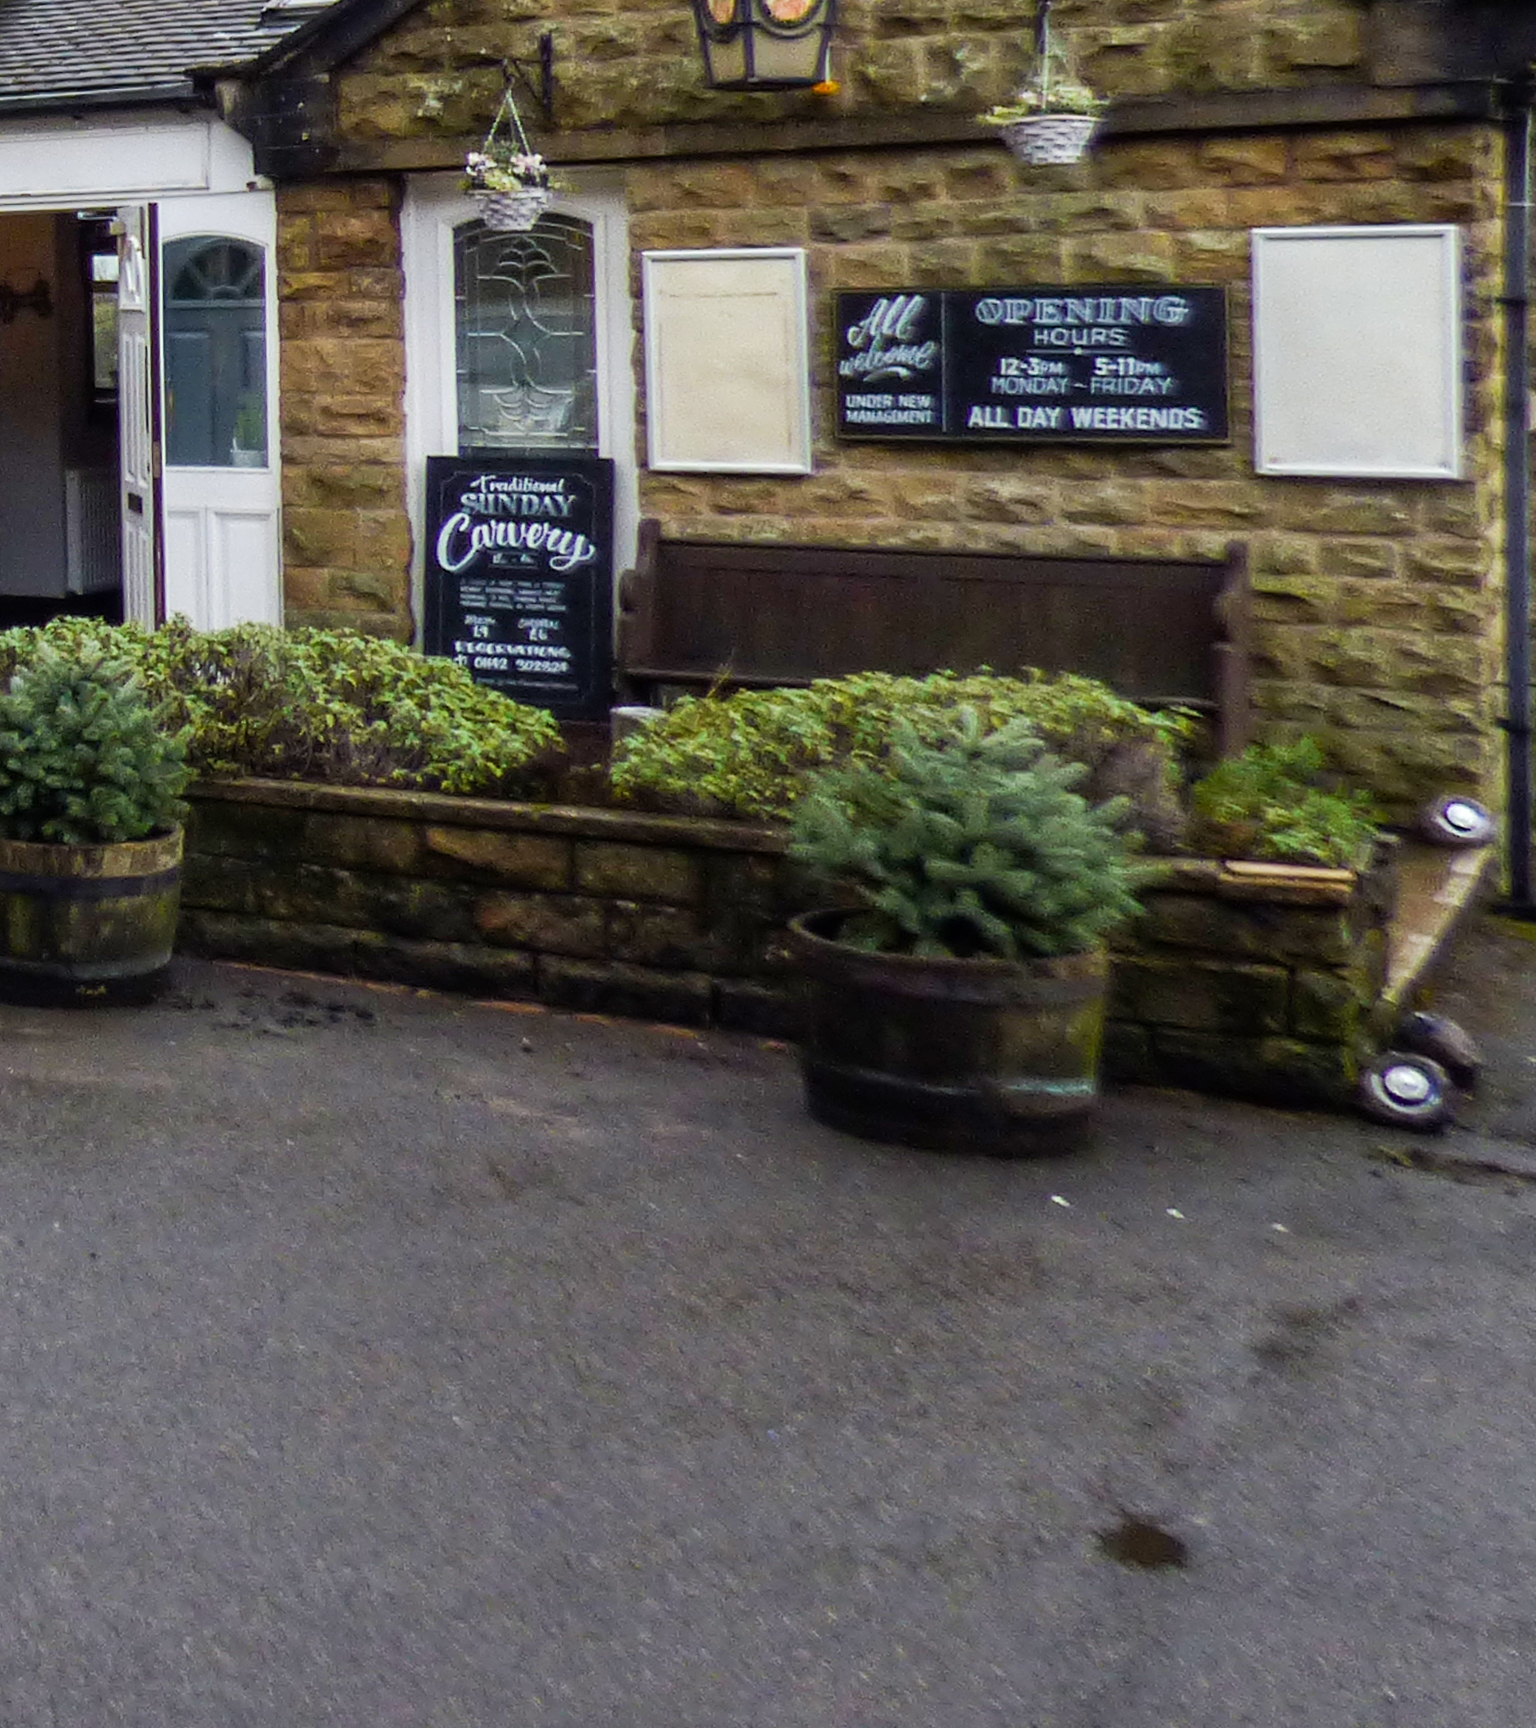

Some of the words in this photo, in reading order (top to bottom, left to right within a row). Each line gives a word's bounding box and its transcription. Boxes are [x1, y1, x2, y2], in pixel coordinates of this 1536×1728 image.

[846, 294, 927, 347] All
[975, 295, 1190, 326] OPENING
[1033, 327, 1130, 346] HOURS
[839, 332, 936, 375] welcome
[999, 356, 1065, 376] 12-3PM
[1094, 356, 1166, 376] 5-11PM
[991, 377, 1069, 395] MONDAY
[1090, 377, 1173, 395] FRIDAY
[846, 394, 892, 408] UNDER
[898, 394, 931, 409] NEW
[846, 409, 933, 424] MANAGEMENT
[967, 405, 1014, 429] ALL
[1016, 406, 1061, 429] DAY
[1070, 407, 1204, 430] WEEKENDS
[469, 474, 566, 494] Traditional
[460, 492, 578, 518] SUNDAY
[436, 512, 596, 572] Carvery
